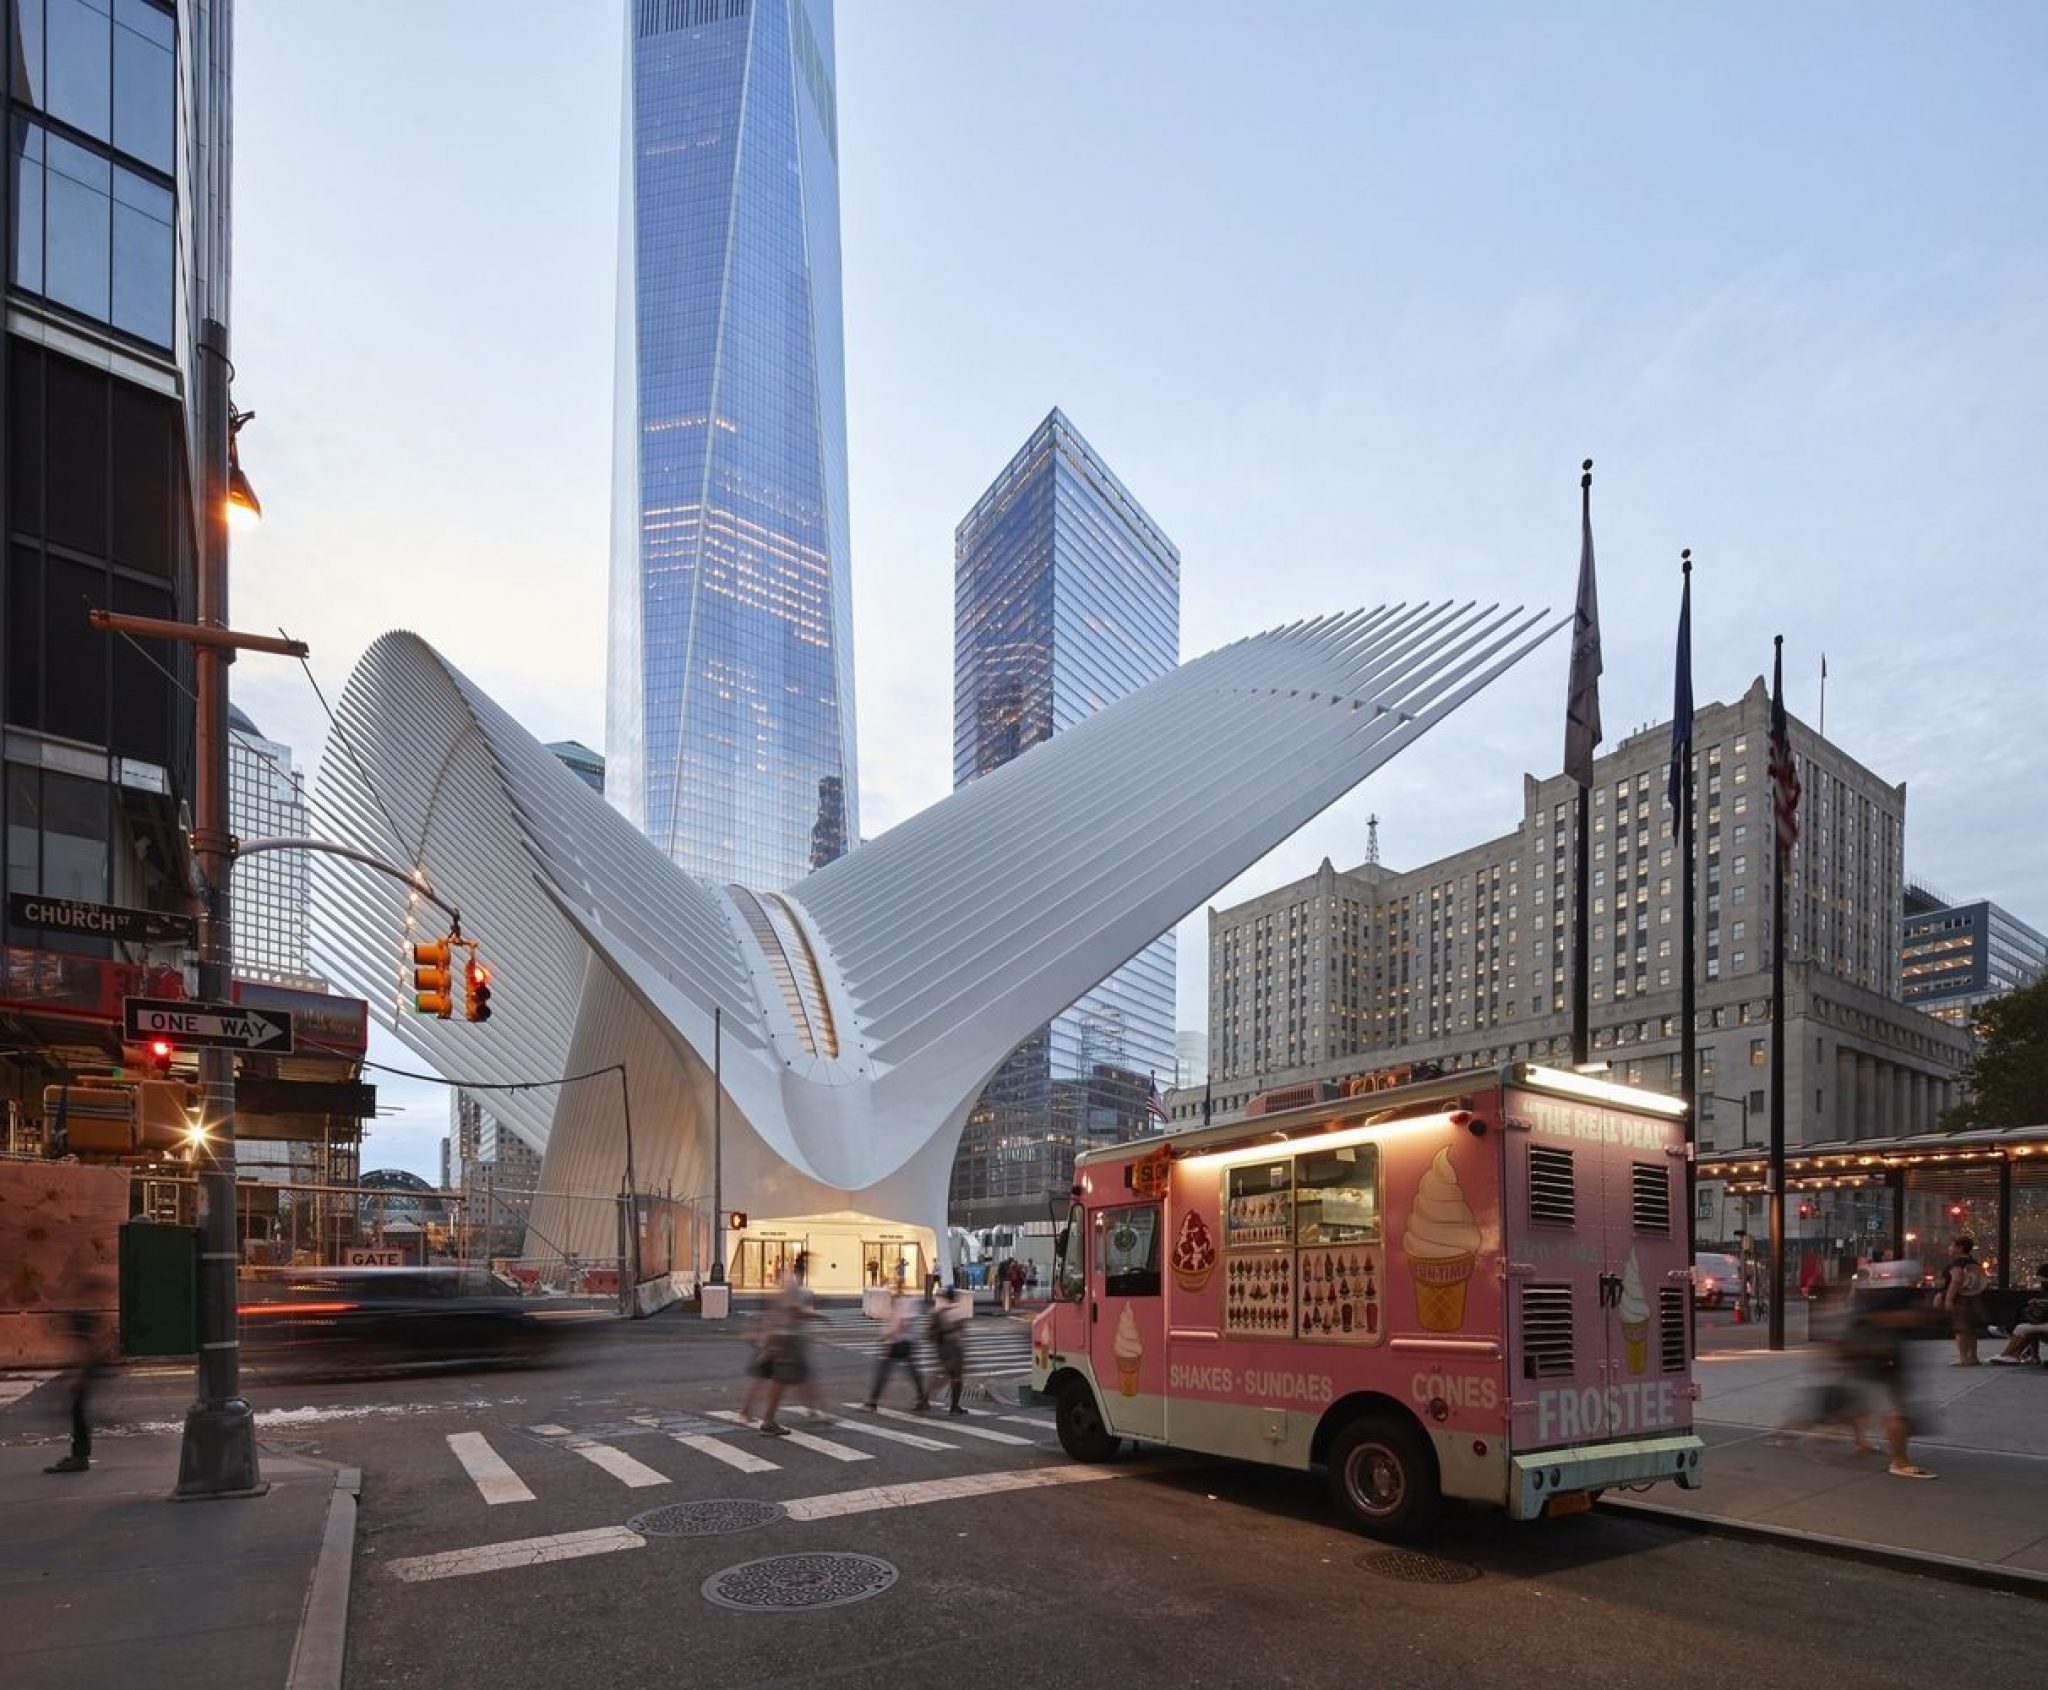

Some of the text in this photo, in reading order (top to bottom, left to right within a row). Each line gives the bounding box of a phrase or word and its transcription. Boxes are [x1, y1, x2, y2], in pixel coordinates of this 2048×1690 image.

[25, 903, 116, 932] CHURCH
[117, 915, 131, 926] ST
[151, 1013, 268, 1038] ONE WAY
[1574, 1109, 1620, 1143] REAL
[352, 1253, 399, 1265] GATE
[1170, 1364, 1334, 1402] SHAKES SUNDAES
[1411, 1373, 1498, 1410] CONES
[1538, 1381, 1676, 1441] FROSTEE
